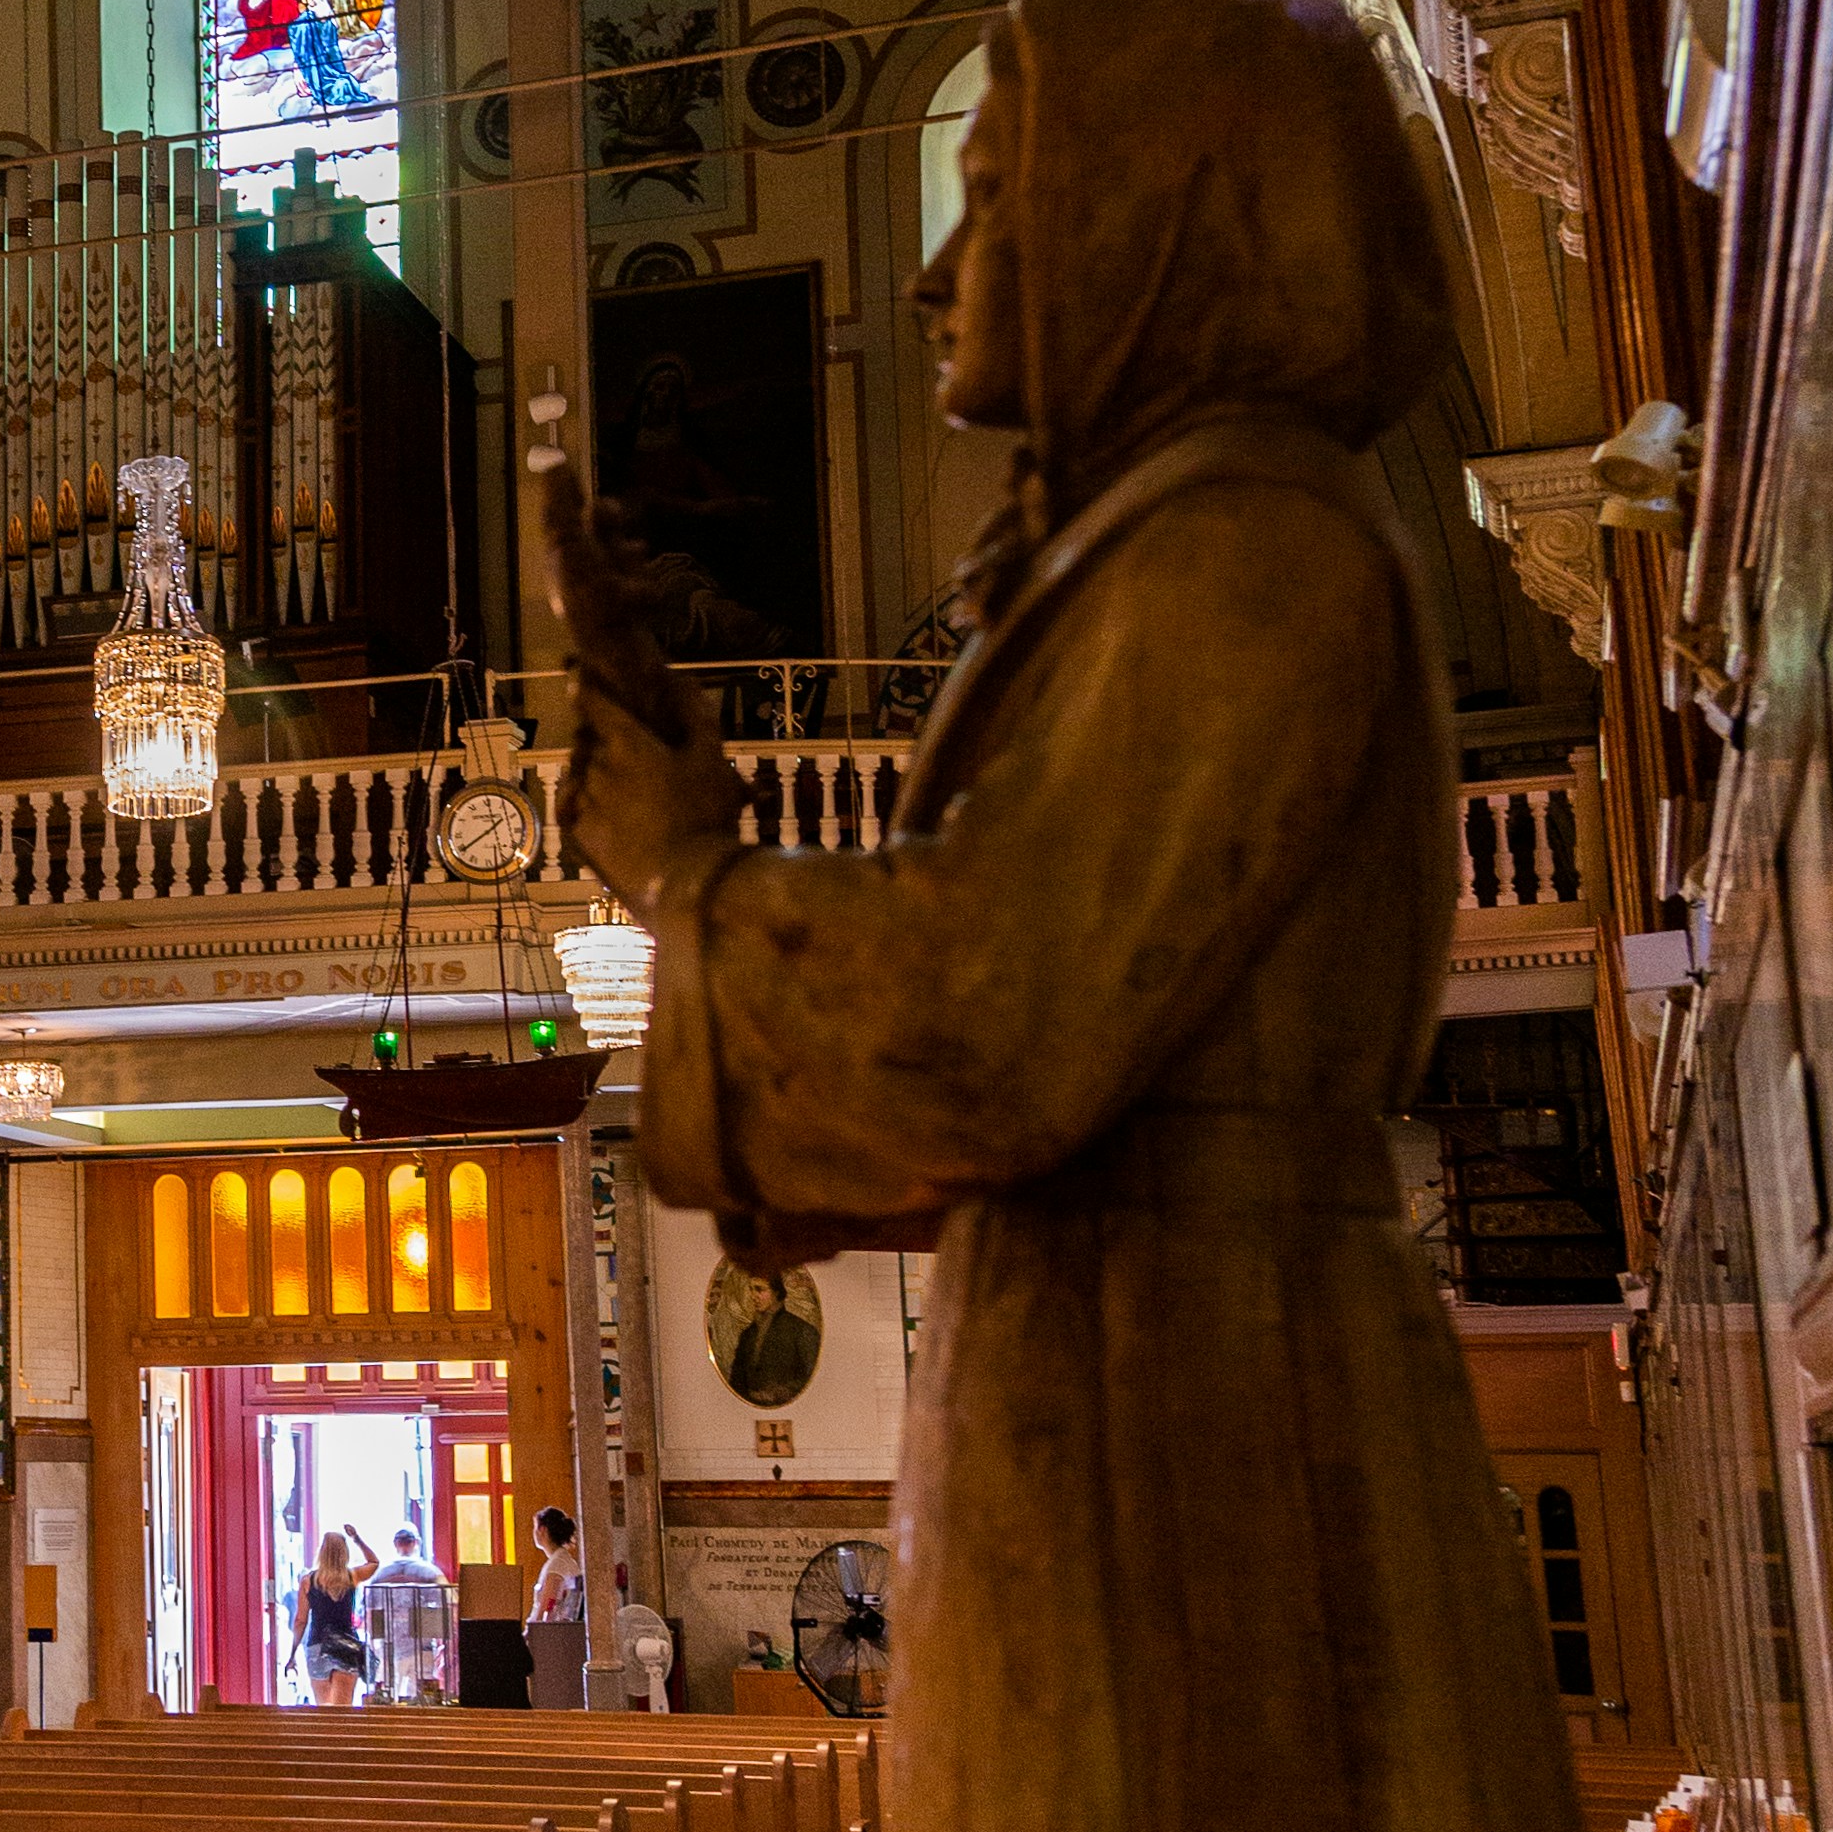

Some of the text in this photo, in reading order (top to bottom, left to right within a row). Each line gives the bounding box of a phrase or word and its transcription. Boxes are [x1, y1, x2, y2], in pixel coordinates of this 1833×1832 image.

[98, 974, 187, 1001] ORA
[212, 968, 306, 996] PRO
[326, 959, 468, 991] NOBIS
